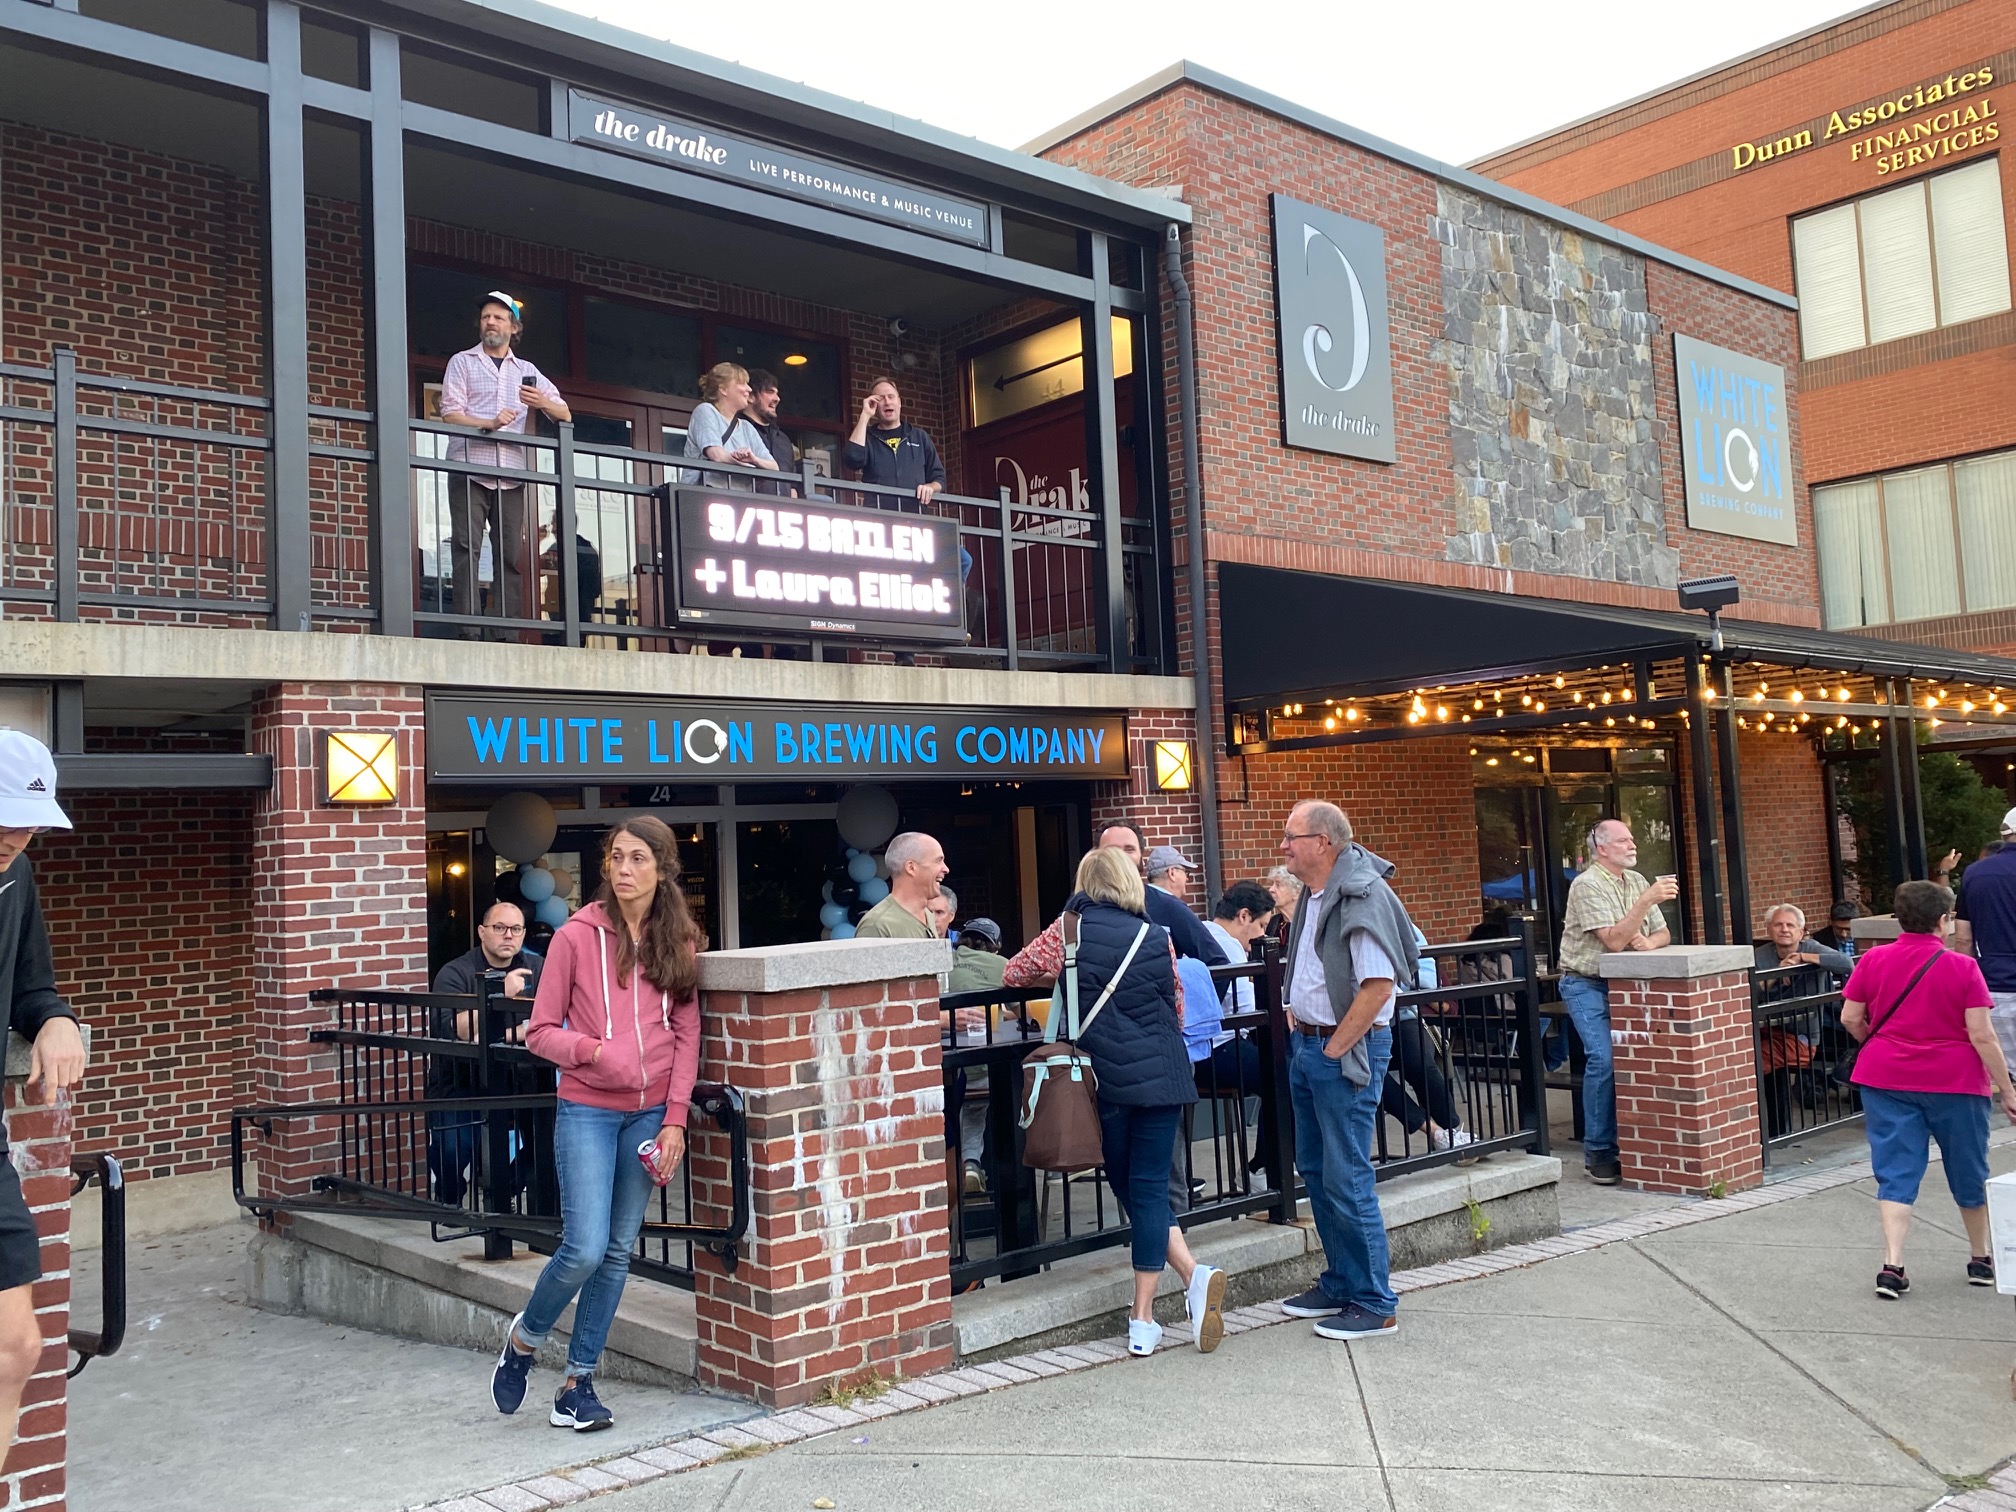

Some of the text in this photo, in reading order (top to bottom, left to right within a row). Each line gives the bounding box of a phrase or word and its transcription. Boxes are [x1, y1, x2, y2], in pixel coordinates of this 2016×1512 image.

[593, 111, 728, 166] the drake
[1732, 66, 1995, 171] Dunn Associates
[1850, 99, 1998, 162] FINANCIAL
[1876, 122, 2000, 176] SERVICES
[749, 158, 974, 230] LIVE PERFORMANCE & MUSIC VENUE
[1300, 404, 1380, 438] the drake
[1690, 359, 1779, 434] WHITE
[1029, 475, 1049, 490] the
[1693, 416, 1784, 500] LION
[994, 456, 1090, 531] Drak
[1700, 491, 1785, 521] BREWING COMPANY
[707, 502, 936, 564] 9/15 BAILEN
[693, 558, 952, 614] + Laura Elliot
[810, 620, 856, 631] SIGN Dynamics
[465, 716, 1106, 766] WHITE LION BREWING COMPANY
[649, 786, 671, 803] 24
